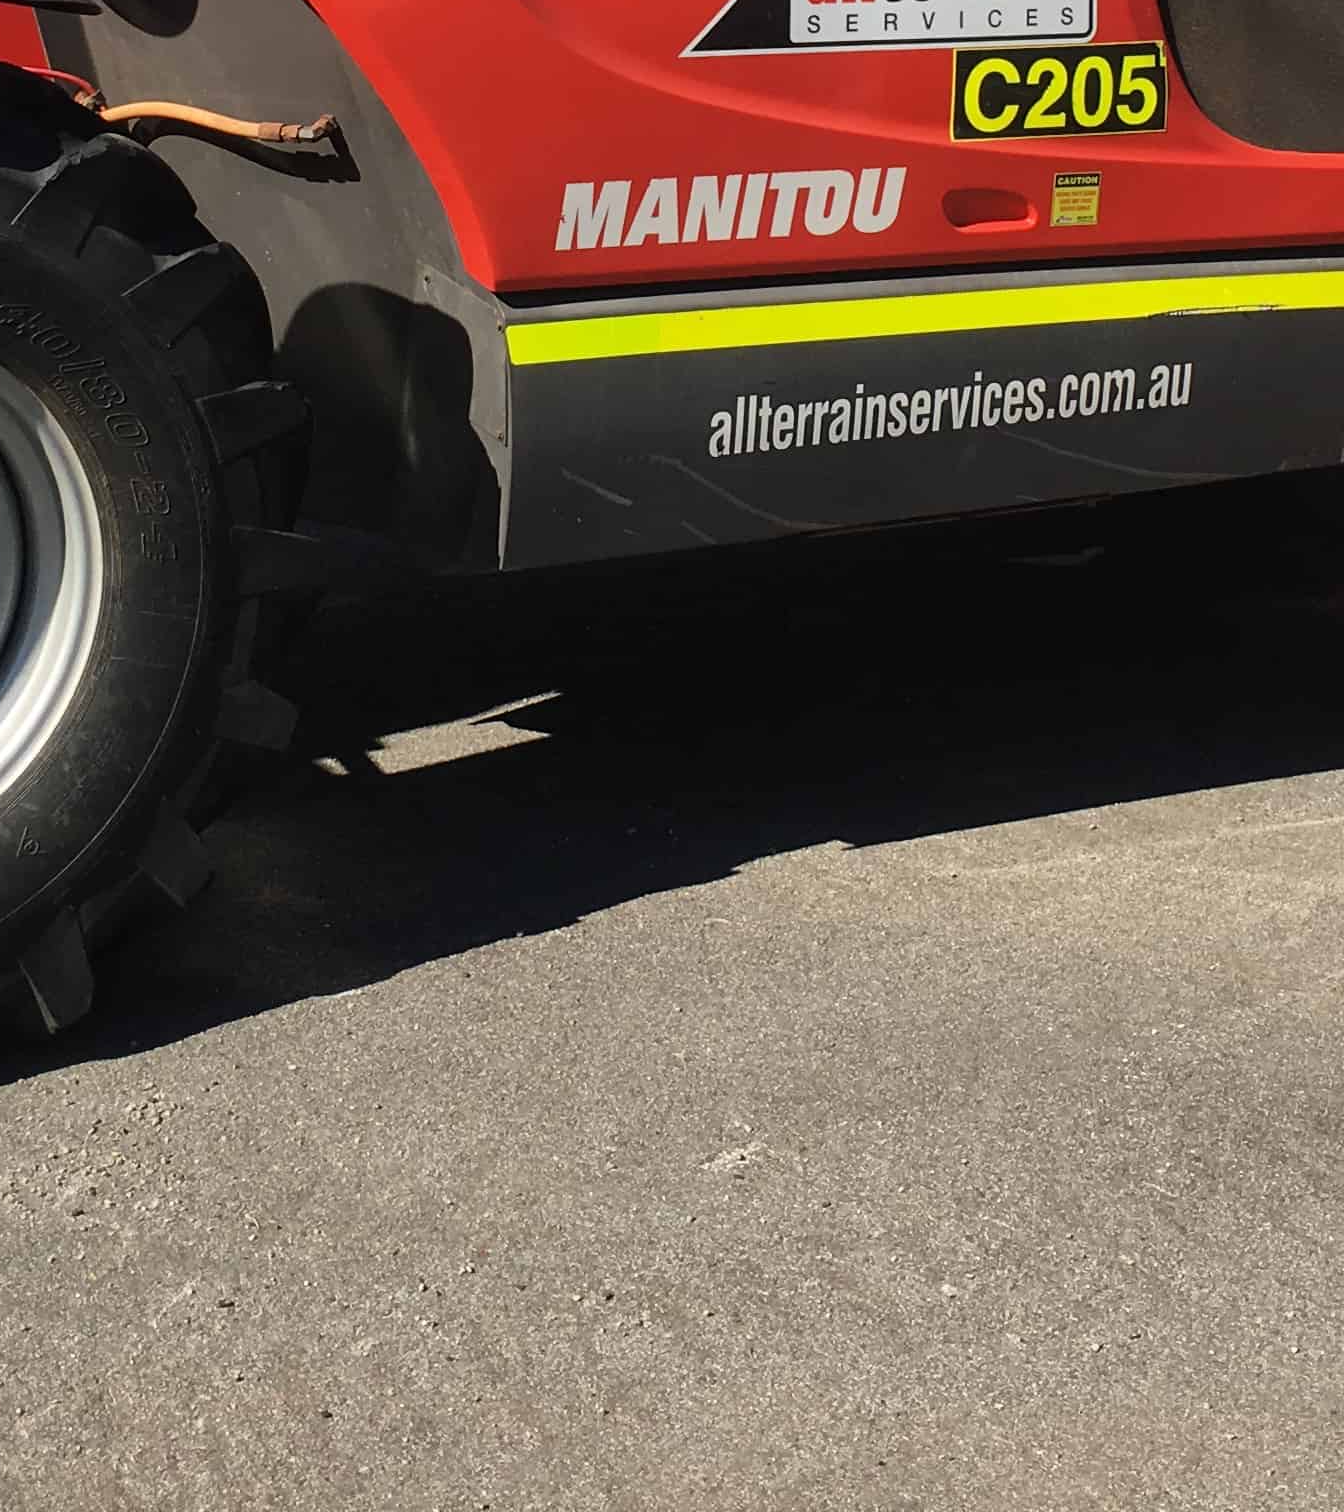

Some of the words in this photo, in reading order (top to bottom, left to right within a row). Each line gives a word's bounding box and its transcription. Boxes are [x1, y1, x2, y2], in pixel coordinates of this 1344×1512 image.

[807, 7, 1074, 34] SERVICES
[963, 54, 1158, 134] C205
[555, 166, 907, 251] MANITOU
[1057, 175, 1099, 186] CAUTION
[708, 361, 1193, 458] allterrainservices.com.au
